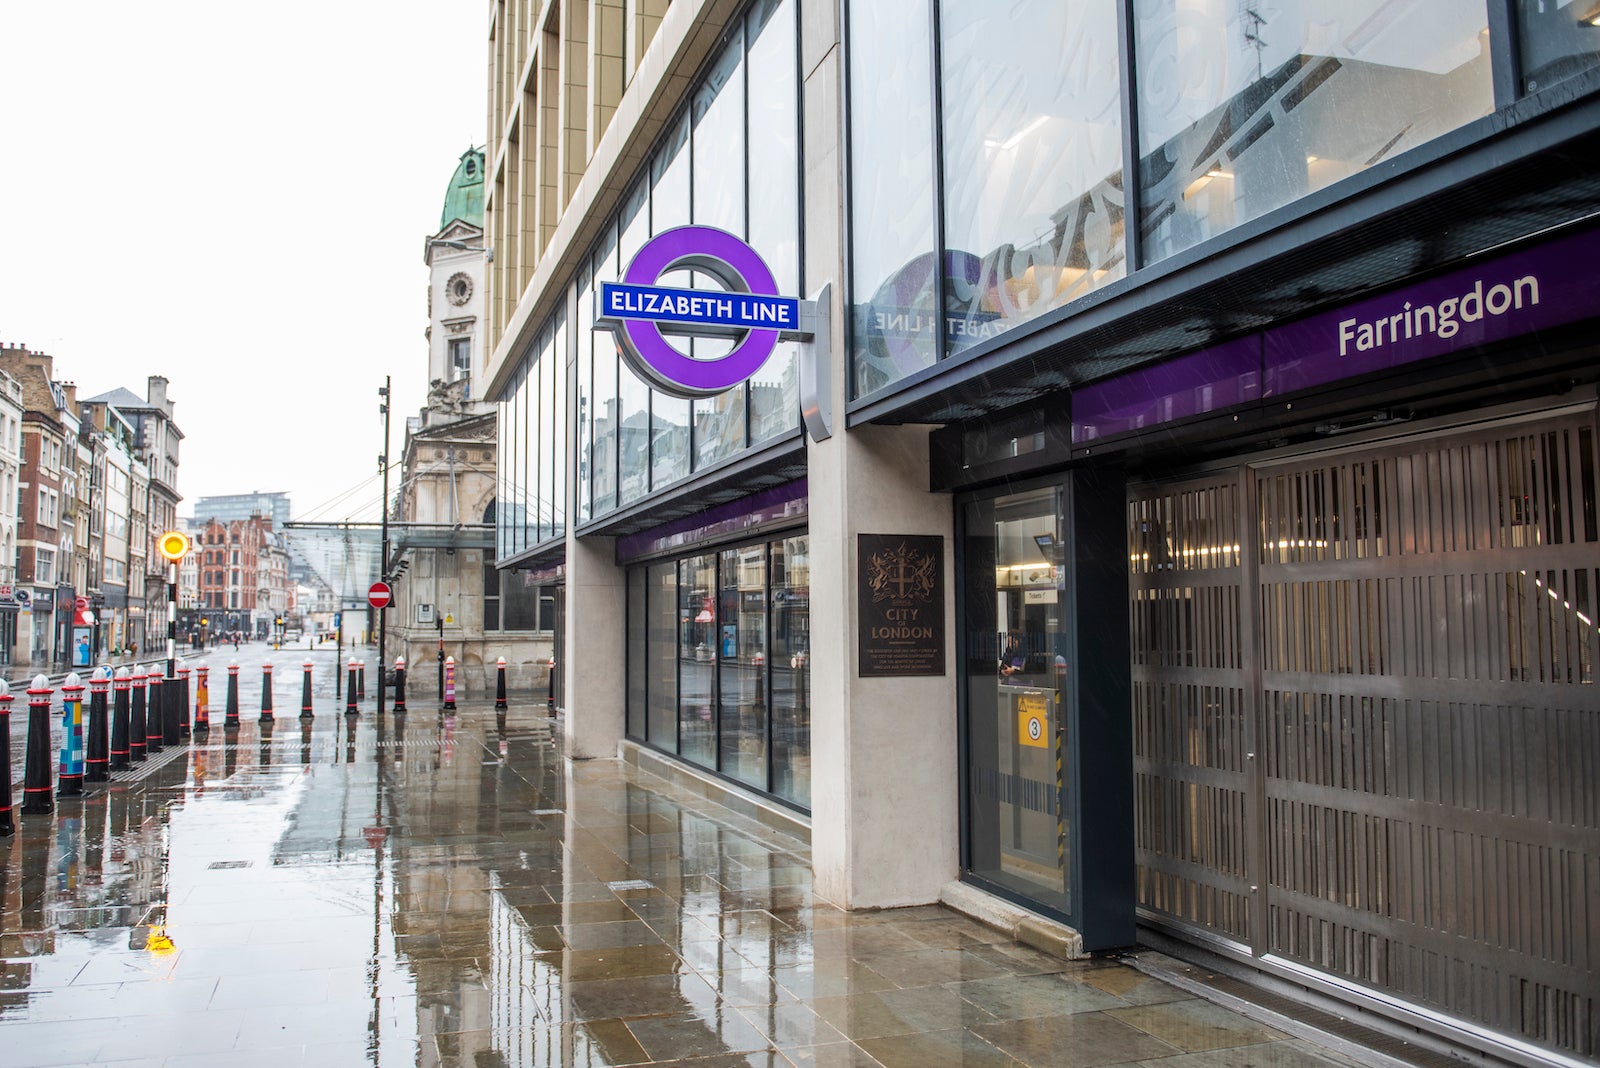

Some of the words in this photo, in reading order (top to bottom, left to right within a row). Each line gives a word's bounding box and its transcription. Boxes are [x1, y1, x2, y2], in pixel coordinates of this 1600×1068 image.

[611, 291, 733, 319] ELIZABETH
[741, 301, 790, 323] LINE
[1338, 274, 1540, 357] Farringdon
[886, 608, 919, 621] CITY
[871, 627, 933, 639] LONDON
[1031, 721, 1038, 736] 3
